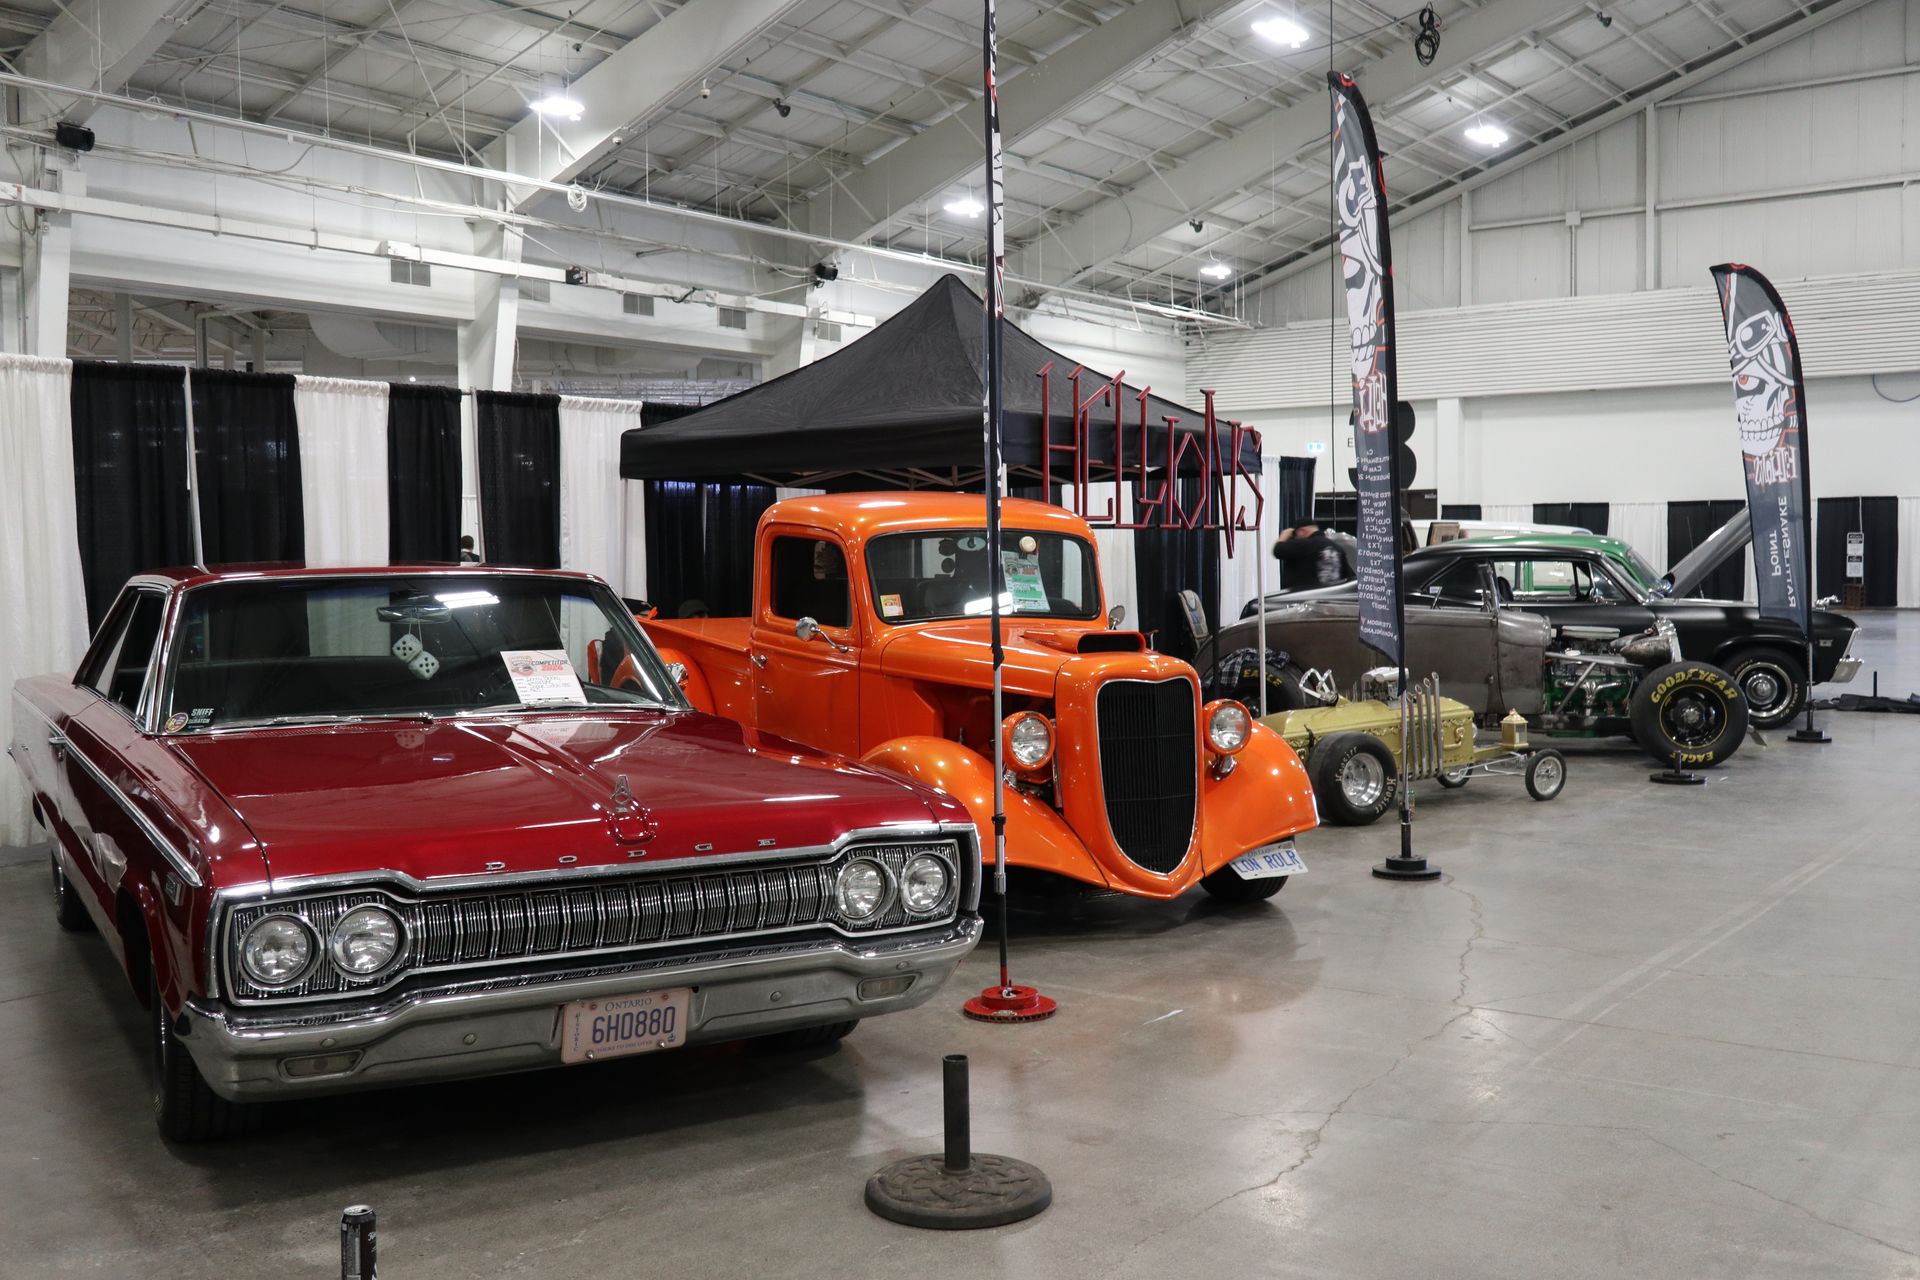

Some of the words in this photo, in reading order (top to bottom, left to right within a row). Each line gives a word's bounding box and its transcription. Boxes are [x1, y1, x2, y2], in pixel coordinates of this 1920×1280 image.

[1036, 361, 1264, 559] HELLIONS
[1650, 668, 1738, 704] GOODYEAR
[191, 708, 215, 717] SNIFF
[485, 838, 776, 871] DODGE
[1264, 850, 1301, 869] ROLR
[604, 998, 652, 1012] ONTARIO
[592, 1006, 676, 1044] 6H0880
